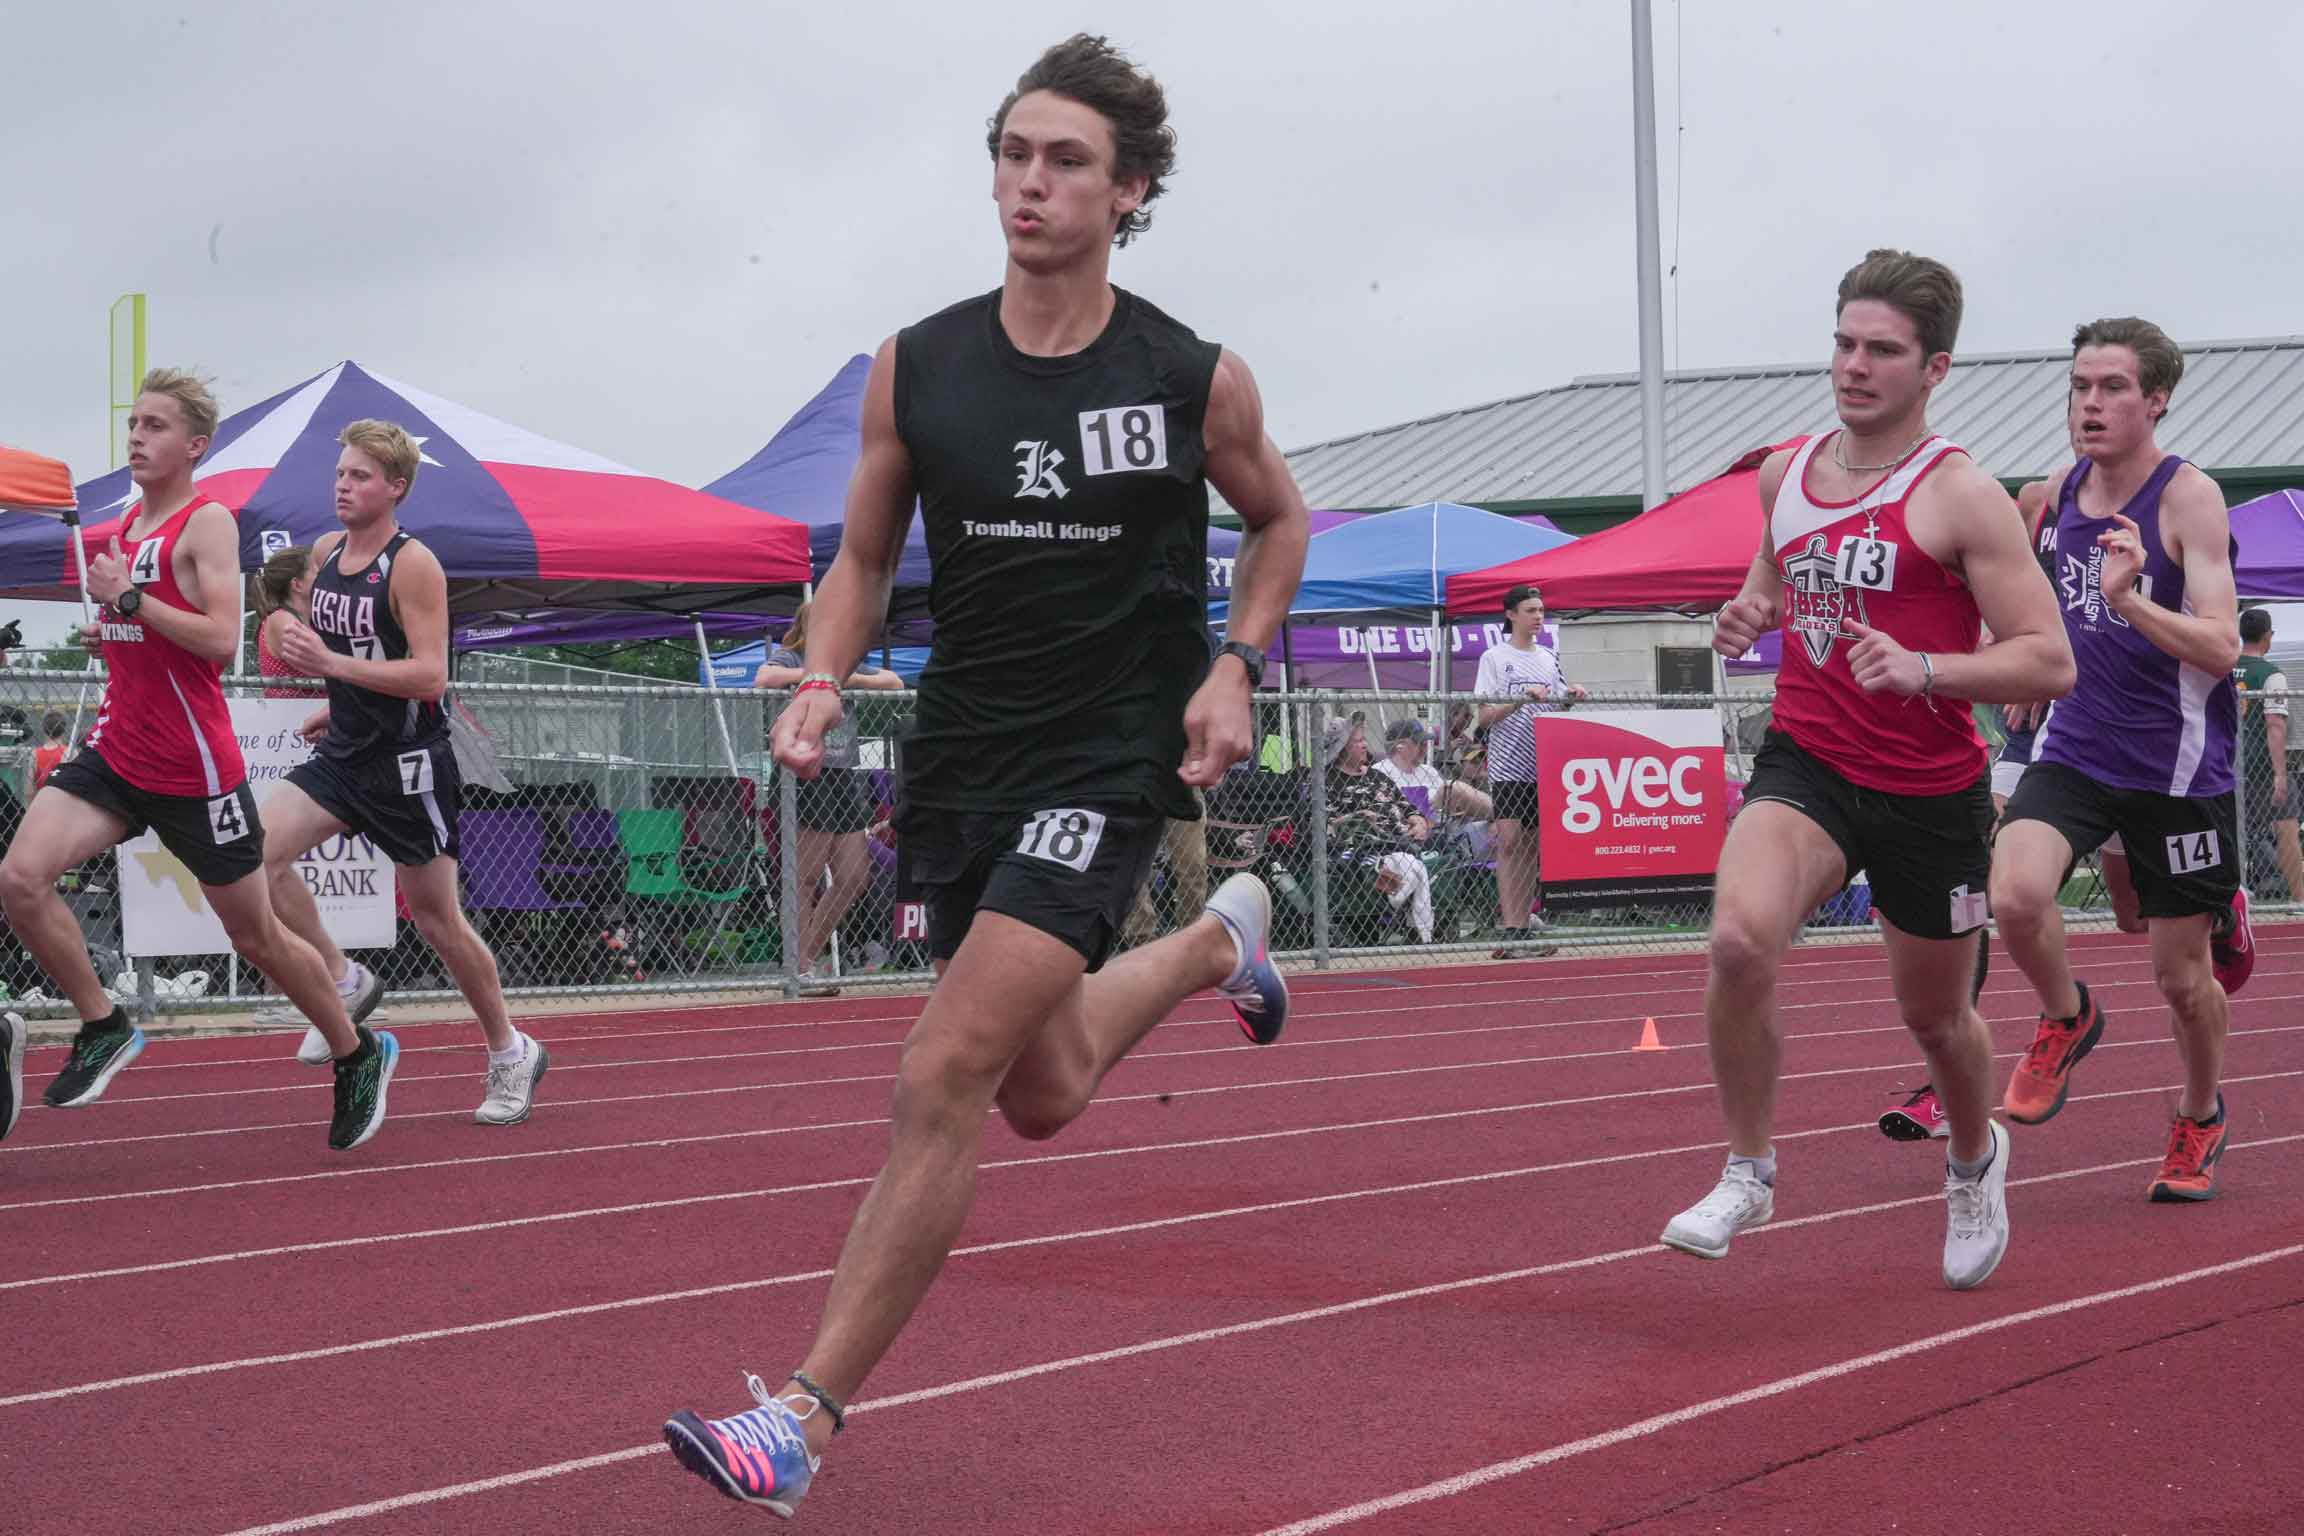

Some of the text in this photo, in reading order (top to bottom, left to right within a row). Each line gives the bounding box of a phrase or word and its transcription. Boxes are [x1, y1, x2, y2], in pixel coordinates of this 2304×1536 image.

[1087, 409, 1156, 471] 18
[962, 520, 1122, 542] Tomball Kings
[135, 541, 158, 579] 4
[1843, 538, 1887, 586] 13
[2088, 546, 2101, 587] ROYALS
[311, 588, 376, 637] HSAA
[354, 640, 375, 661] 7
[1339, 626, 1401, 654] ONE
[267, 729, 288, 753] of
[401, 754, 424, 791] 7
[1561, 755, 1703, 834] gvec
[217, 798, 242, 836] 4
[1613, 812, 1669, 830] Delivering
[1027, 811, 1090, 862] 18
[2170, 832, 2213, 871] 14
[301, 866, 380, 897] BANK
